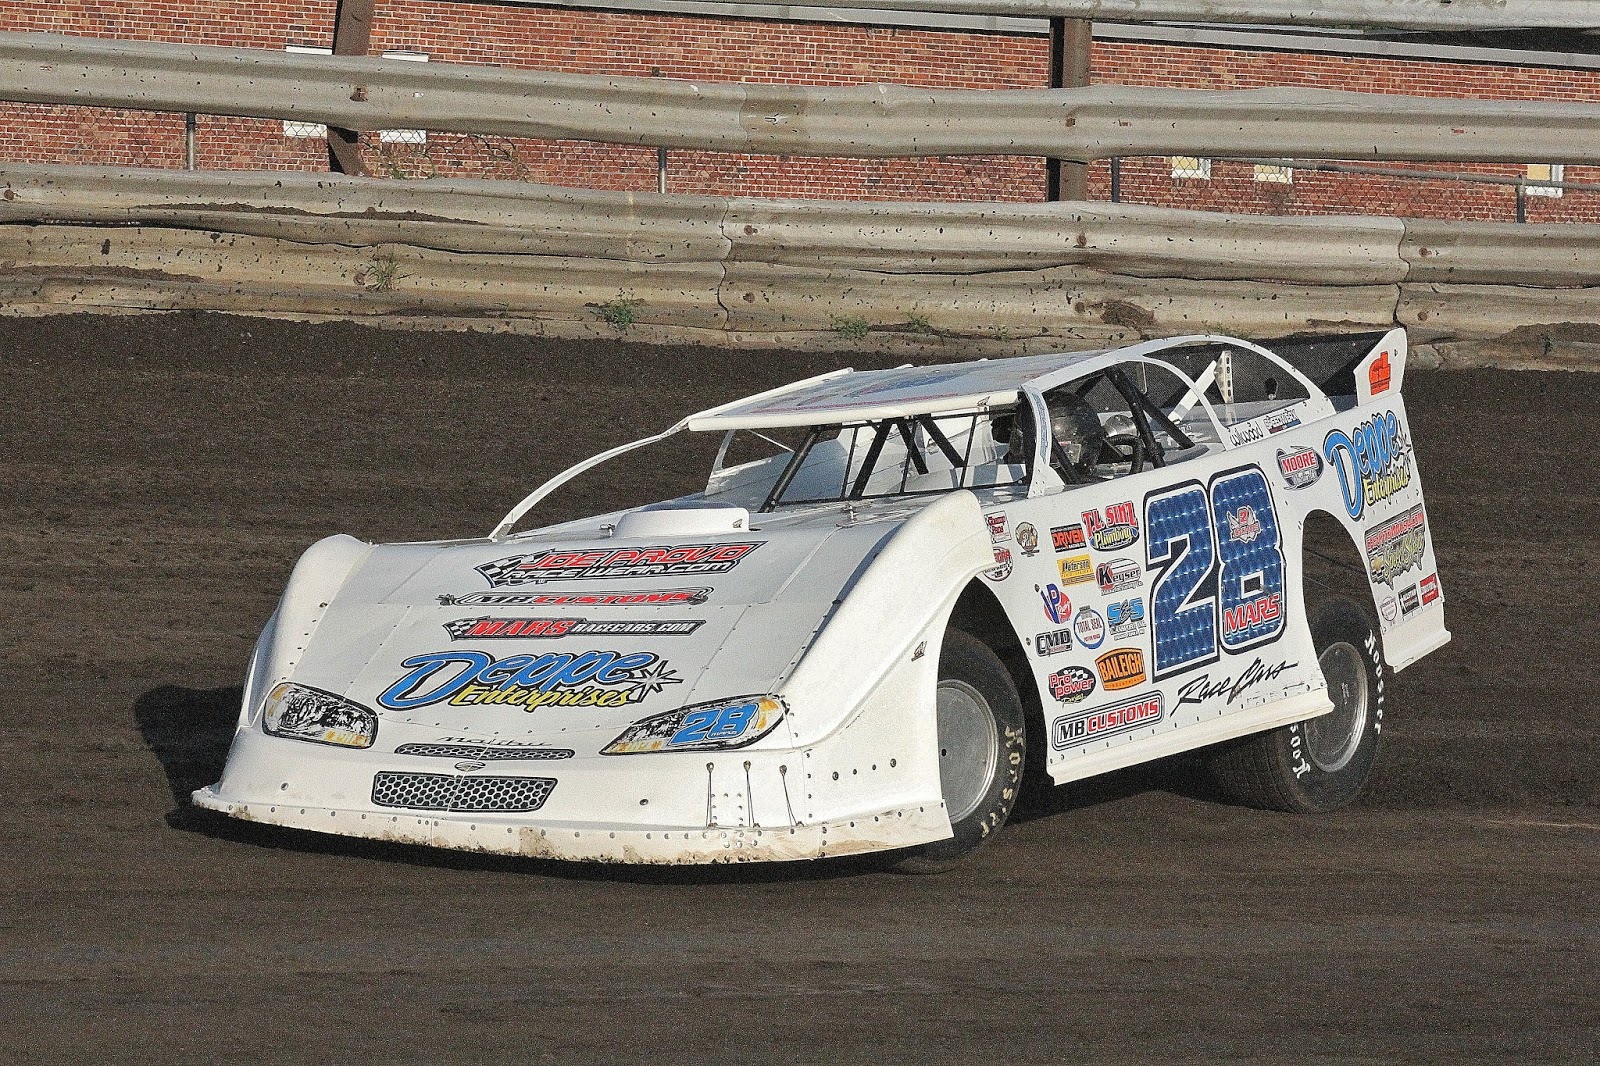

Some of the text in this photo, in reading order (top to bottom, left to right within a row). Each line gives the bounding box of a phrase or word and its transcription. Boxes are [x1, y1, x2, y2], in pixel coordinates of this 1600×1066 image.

[1282, 452, 1316, 473] MOORE
[1323, 409, 1400, 522] Deppe
[1363, 465, 1410, 507] Enterprises
[1051, 529, 1085, 549] DRIVEN
[1094, 527, 1132, 548] Plumbing
[519, 545, 751, 570] JOE PROVO
[1062, 559, 1091, 573] Peterson
[1098, 564, 1140, 588] Keyser
[1143, 463, 1288, 684] 28
[1040, 583, 1062, 625] VP
[1107, 597, 1145, 627] S&S
[1224, 593, 1281, 635] MARS
[464, 620, 697, 635] MARS RACECARS.COM
[1076, 617, 1102, 634] TOTAL SEAL
[1036, 630, 1071, 655] CMD
[376, 650, 660, 711] Deppe
[1050, 673, 1072, 688] Pro
[1098, 653, 1143, 681] BAILEIGH
[447, 682, 631, 712] Enterprises
[1055, 678, 1094, 700] power
[1170, 674, 1232, 718] Race
[667, 702, 760, 746] 28
[1058, 721, 1085, 741] MB
[1087, 699, 1159, 733] CUSTOMS
[1289, 723, 1311, 779] Hoos
